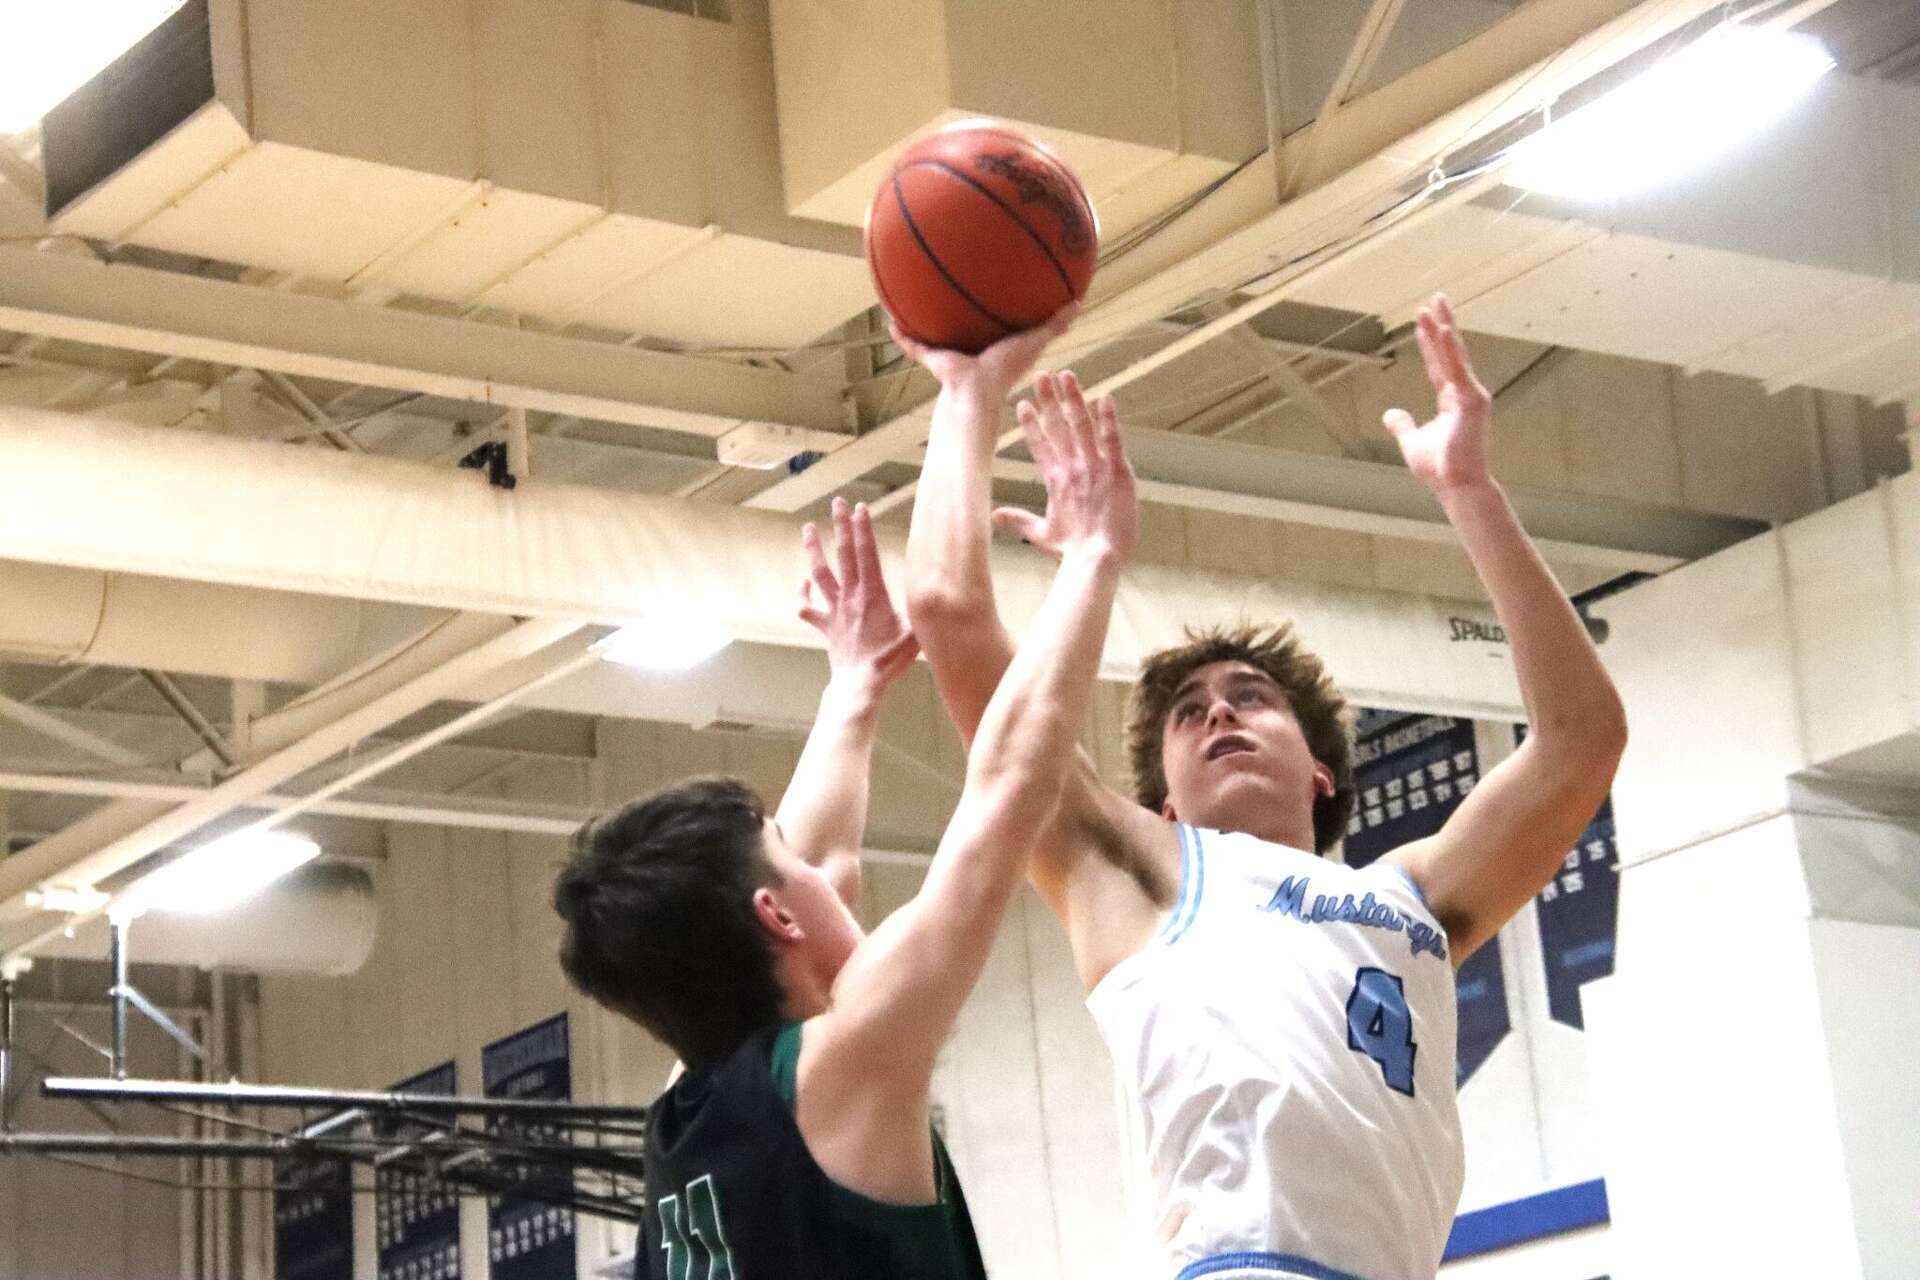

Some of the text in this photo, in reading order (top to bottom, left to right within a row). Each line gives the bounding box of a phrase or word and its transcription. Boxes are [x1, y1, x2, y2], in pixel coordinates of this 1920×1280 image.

[1449, 617, 1509, 644] SPALD
[1257, 874, 1446, 961] Mustangs
[1346, 966, 1418, 1098] 4
[658, 1173, 736, 1280] 11
